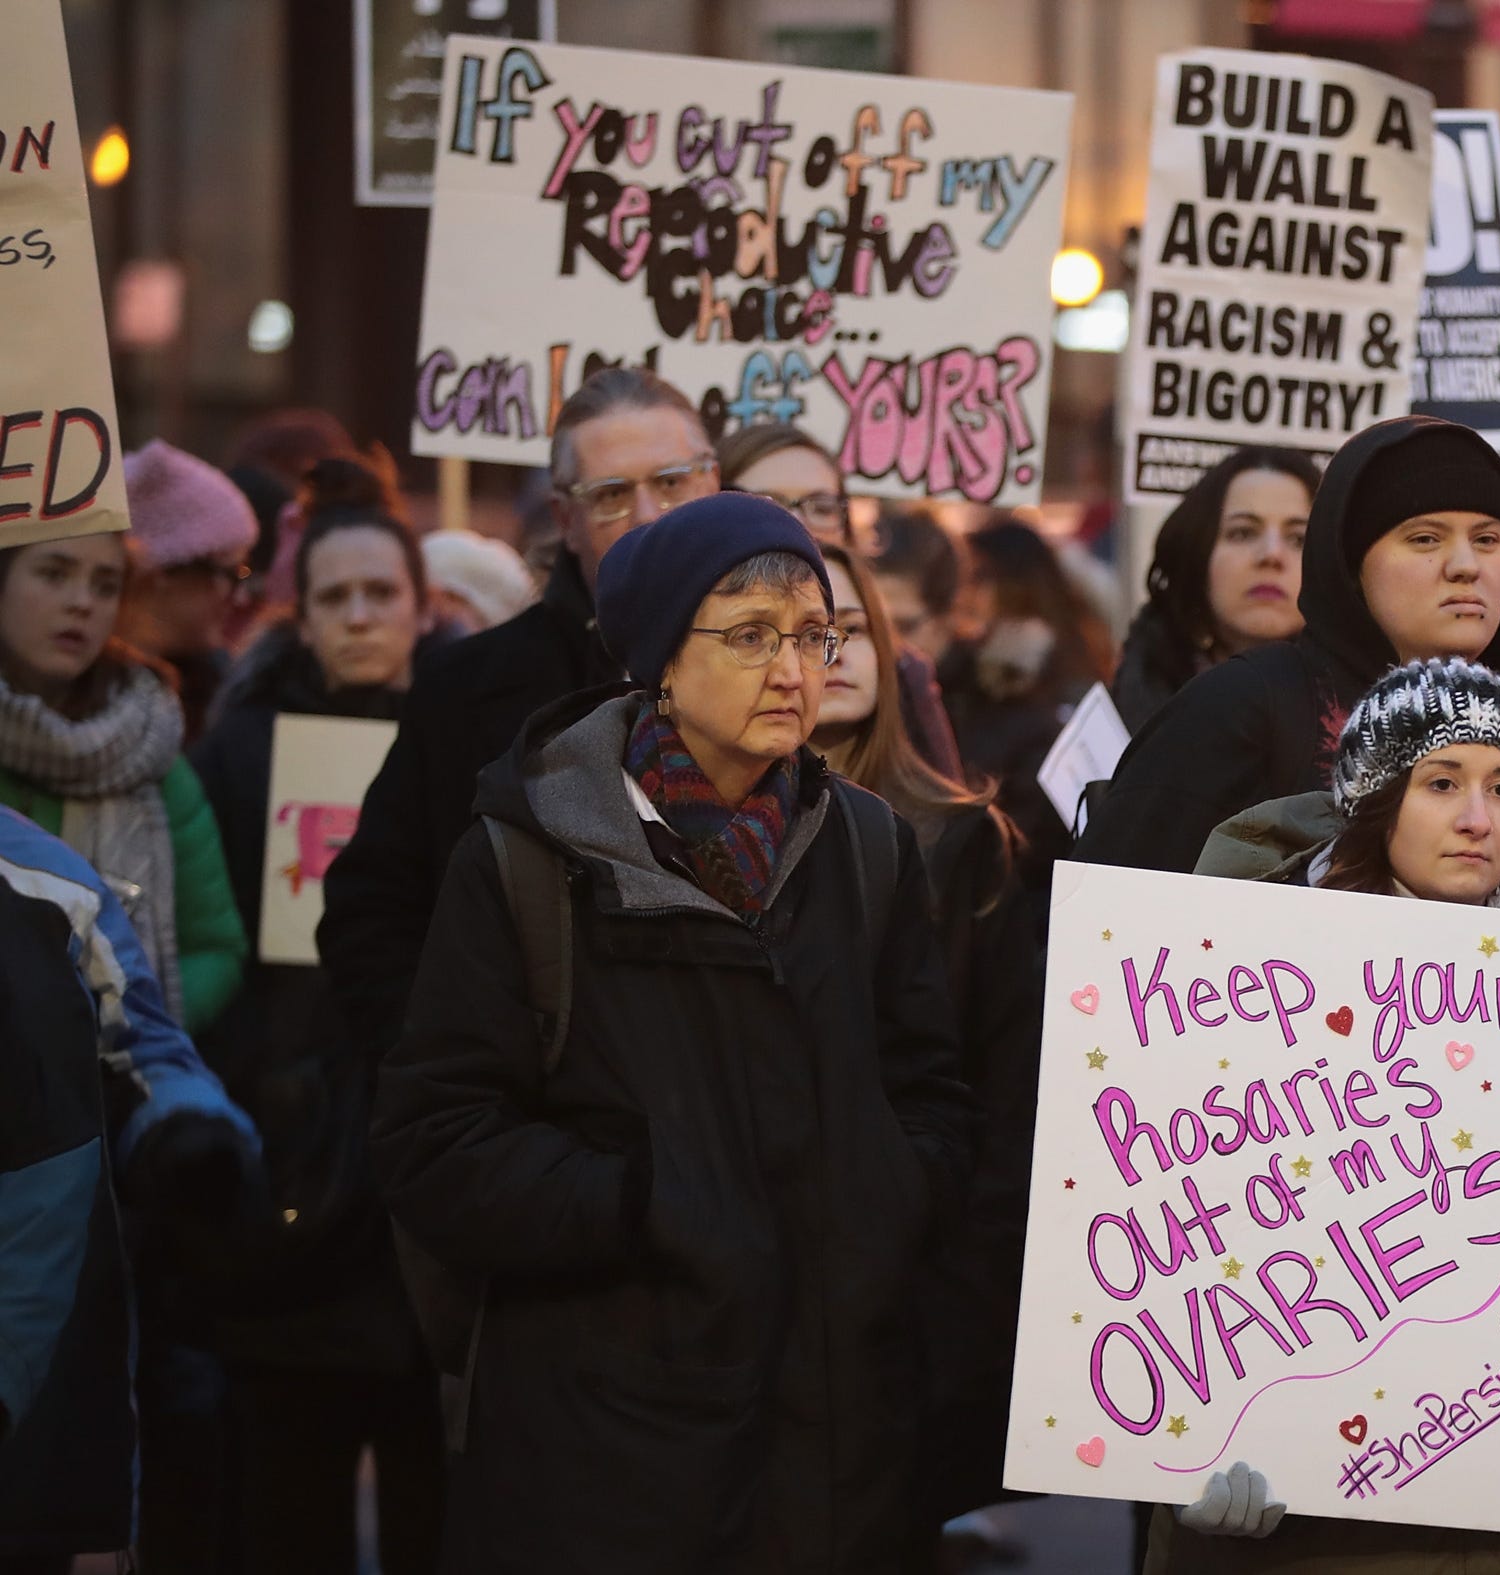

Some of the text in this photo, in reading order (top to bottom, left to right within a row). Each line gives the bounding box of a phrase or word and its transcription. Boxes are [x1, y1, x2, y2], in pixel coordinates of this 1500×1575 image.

[452, 47, 1055, 249] If you cut off my
[1175, 64, 1414, 151] BUILD A
[1201, 135, 1378, 213] WALL
[1161, 203, 1404, 283] AGAINST
[1148, 292, 1343, 361] RACISM
[1362, 312, 1400, 370] &
[820, 335, 1040, 502] YOURS?
[1152, 362, 1384, 432] BIGOTRY!
[1120, 946, 1316, 1048] Keep
[1092, 1057, 1443, 1188] Rosaries
[1244, 1152, 1307, 1230] of
[1329, 1121, 1468, 1215] my
